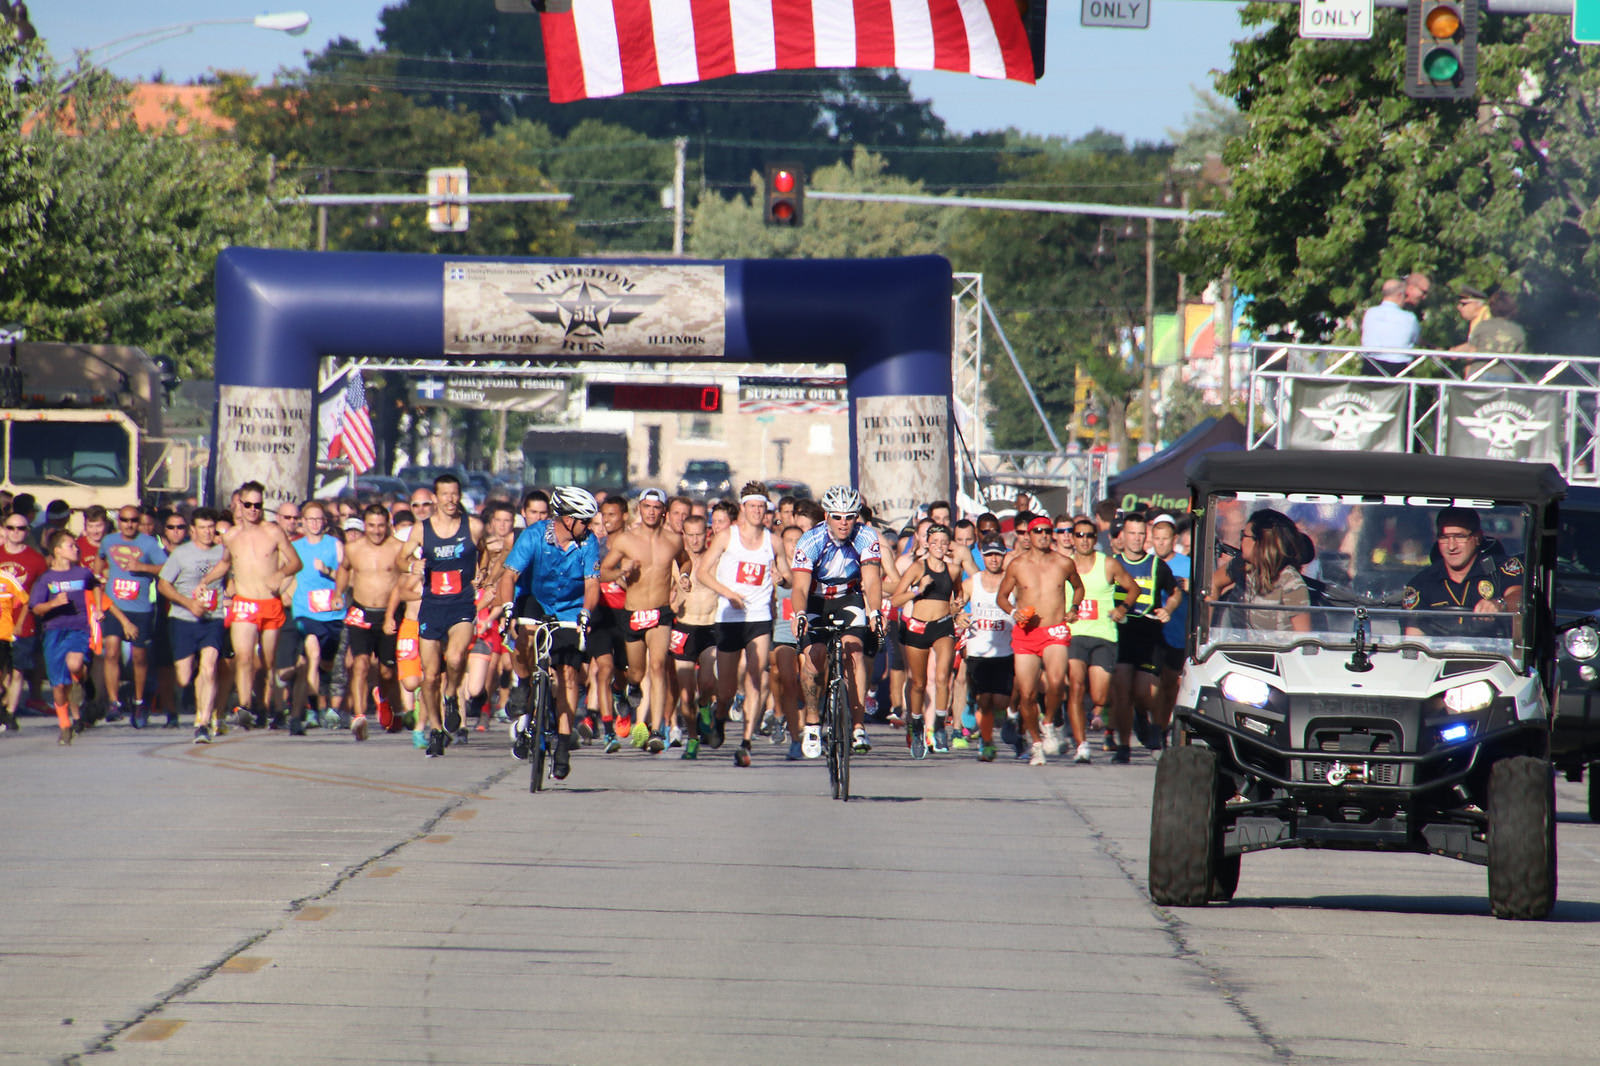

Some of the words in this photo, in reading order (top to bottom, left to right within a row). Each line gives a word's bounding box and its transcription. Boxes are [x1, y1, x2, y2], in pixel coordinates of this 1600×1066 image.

[1090, 1, 1140, 19] ONLY
[1311, 9, 1362, 26] ONLY
[535, 267, 636, 292] FREEDOM
[573, 304, 597, 321] 5K
[562, 340, 605, 352] RUN
[648, 335, 705, 345] ILLINOIS
[449, 389, 486, 401] Trinity
[701, 386, 720, 411] 0
[745, 388, 805, 400] SUPPORT
[808, 388, 836, 400] OUR
[225, 404, 274, 419] THANK
[279, 408, 307, 420] YOU
[863, 415, 912, 429] THANK
[919, 415, 947, 427] YOU
[240, 423, 256, 435] TO
[261, 424, 293, 437] OUR
[878, 432, 895, 445] TO
[901, 432, 931, 444] OUR
[234, 440, 296, 455] TROOPS!
[874, 449, 935, 462] TROOPS!
[1235, 491, 1495, 509] POLICE
[743, 562, 761, 576] 479
[442, 573, 449, 585] 1
